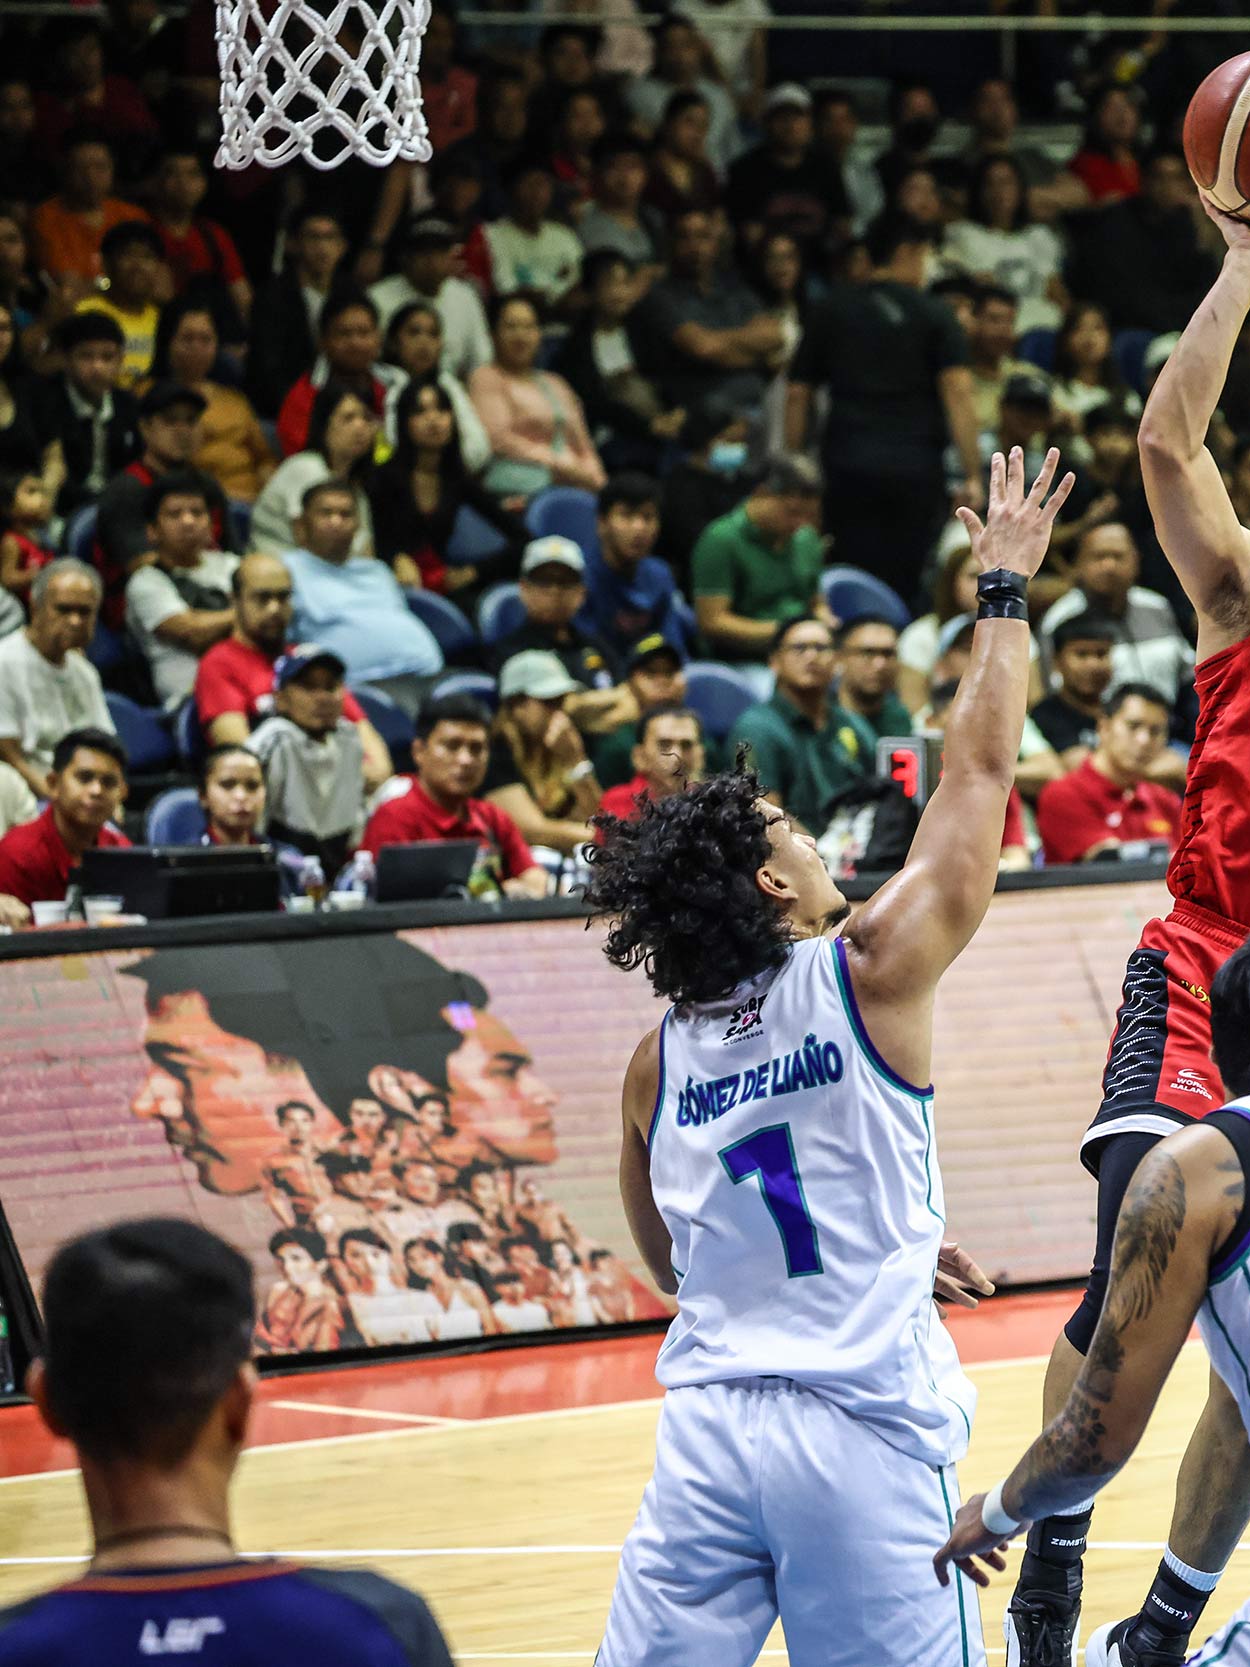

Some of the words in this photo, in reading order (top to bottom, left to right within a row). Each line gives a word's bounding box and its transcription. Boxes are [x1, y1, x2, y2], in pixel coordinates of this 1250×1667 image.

[729, 992, 769, 1024] SURF
[676, 1074, 741, 1127] GÓMEZ
[739, 1061, 770, 1105] DE
[771, 1032, 844, 1097] LIAÑO
[1176, 1077, 1208, 1093] WORL
[717, 1122, 824, 1279] 1
